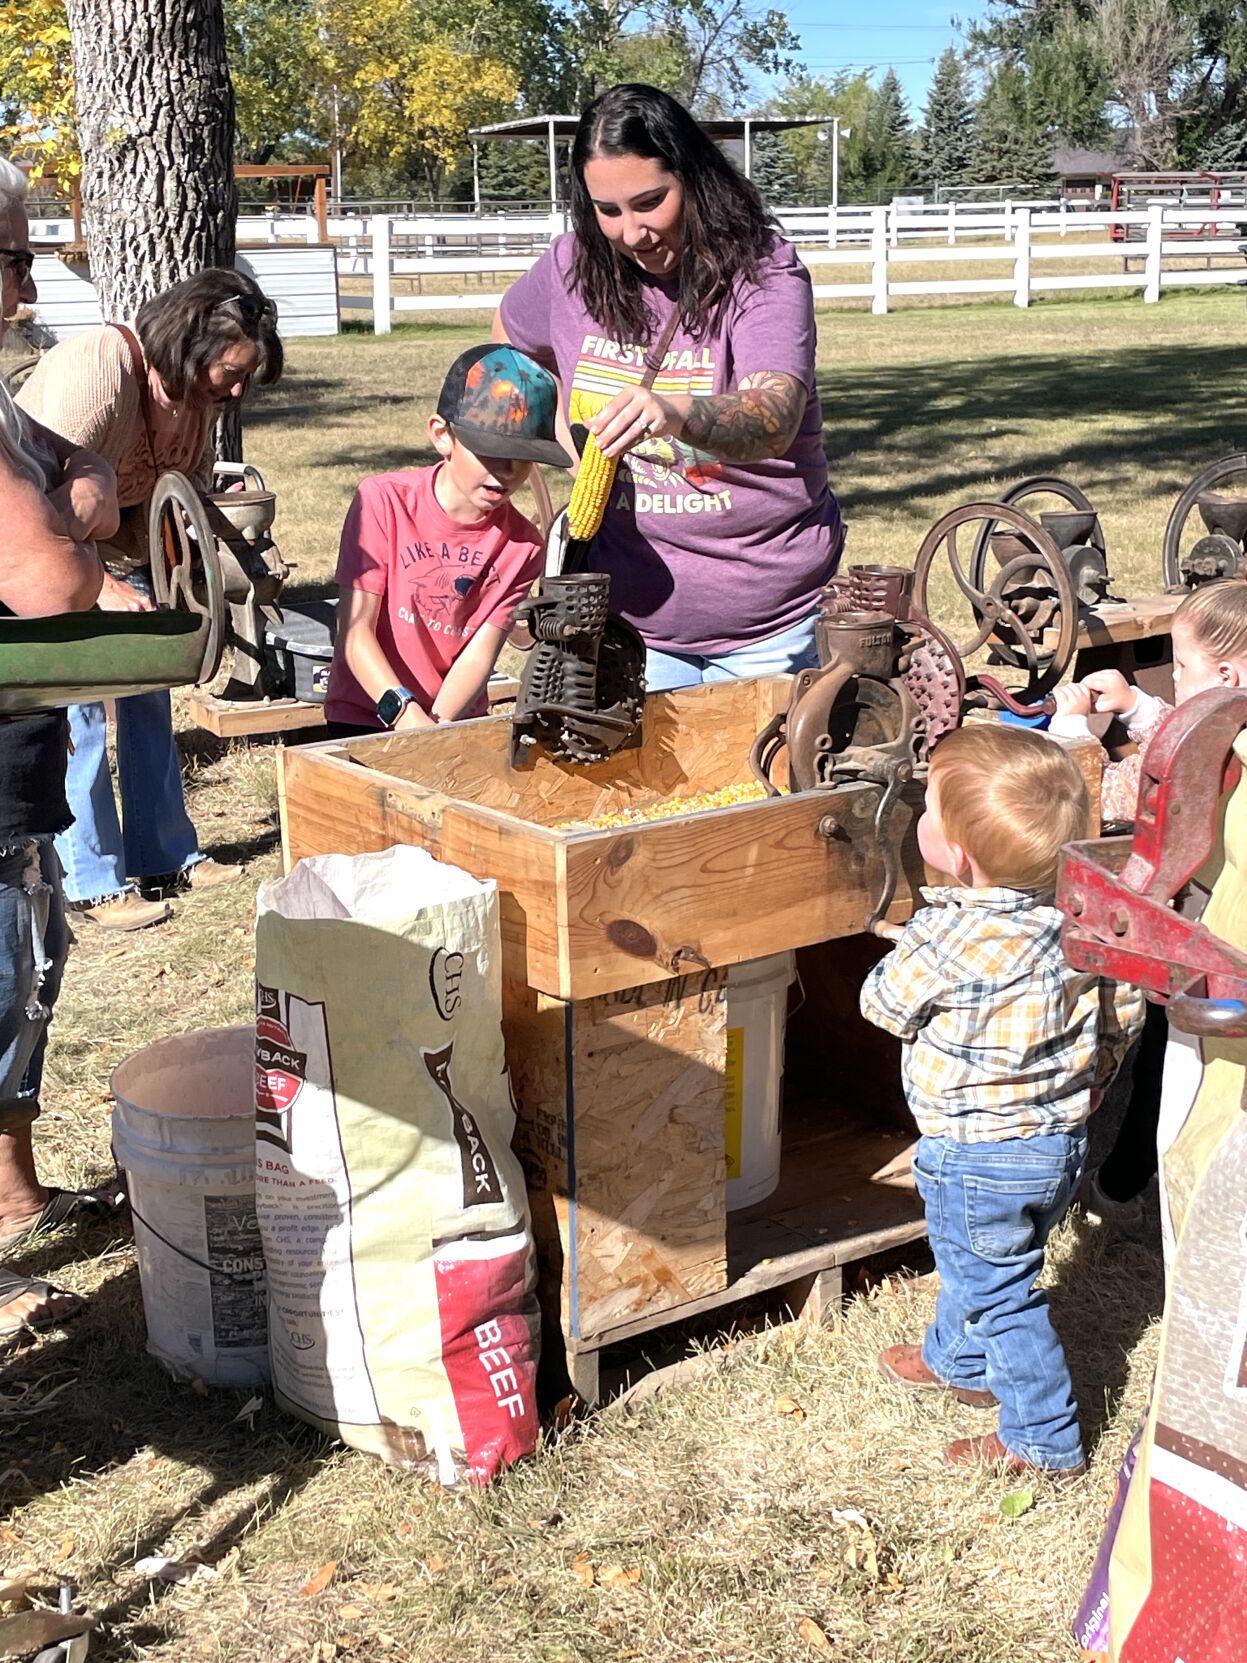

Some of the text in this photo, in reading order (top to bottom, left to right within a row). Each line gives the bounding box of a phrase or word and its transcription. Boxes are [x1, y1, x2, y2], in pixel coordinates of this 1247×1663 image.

[581, 335, 648, 366] FIRST
[635, 490, 732, 513] DELIGHT
[400, 541, 434, 568] LIKE
[441, 542, 450, 559] A
[443, 951, 465, 1014] CHS
[266, 1160, 289, 1175] BAG
[272, 1177, 296, 1188] THAN
[474, 1318, 525, 1418] BEEF
